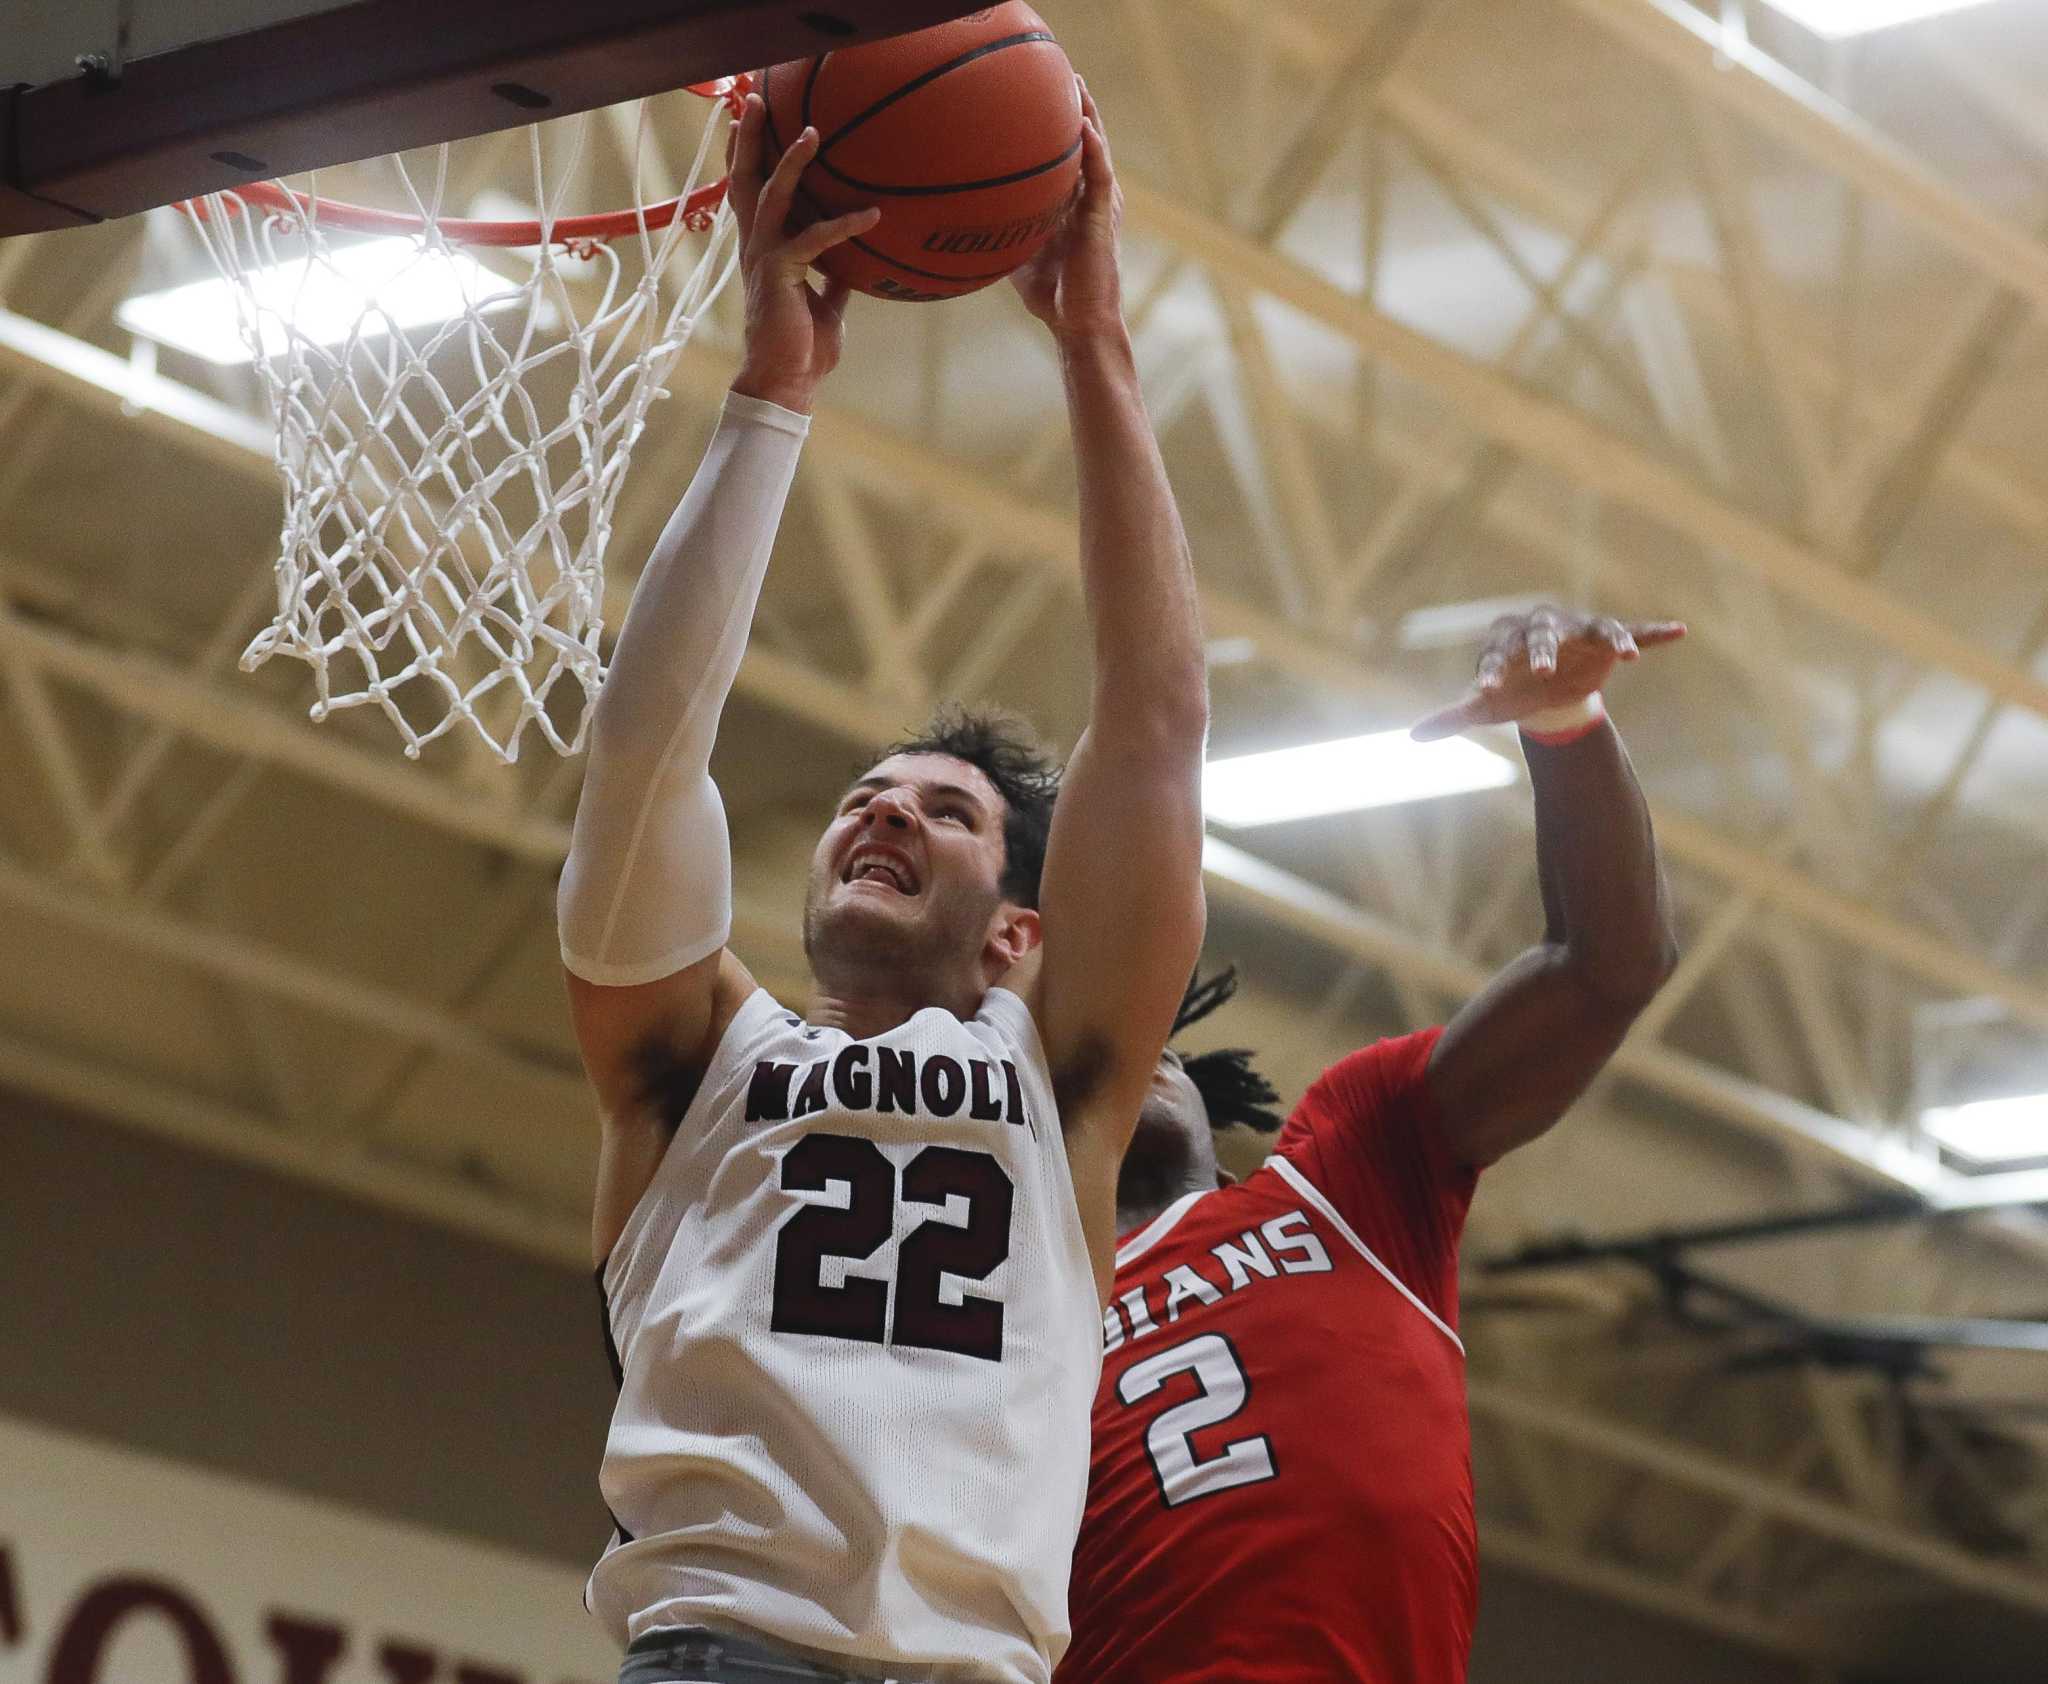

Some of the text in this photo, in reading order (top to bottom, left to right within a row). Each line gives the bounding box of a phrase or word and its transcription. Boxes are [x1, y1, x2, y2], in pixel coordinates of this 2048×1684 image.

[744, 1044, 1037, 1143] MAGNOLI
[770, 1132, 1015, 1363] 22
[1115, 1331, 1280, 1509] 2
